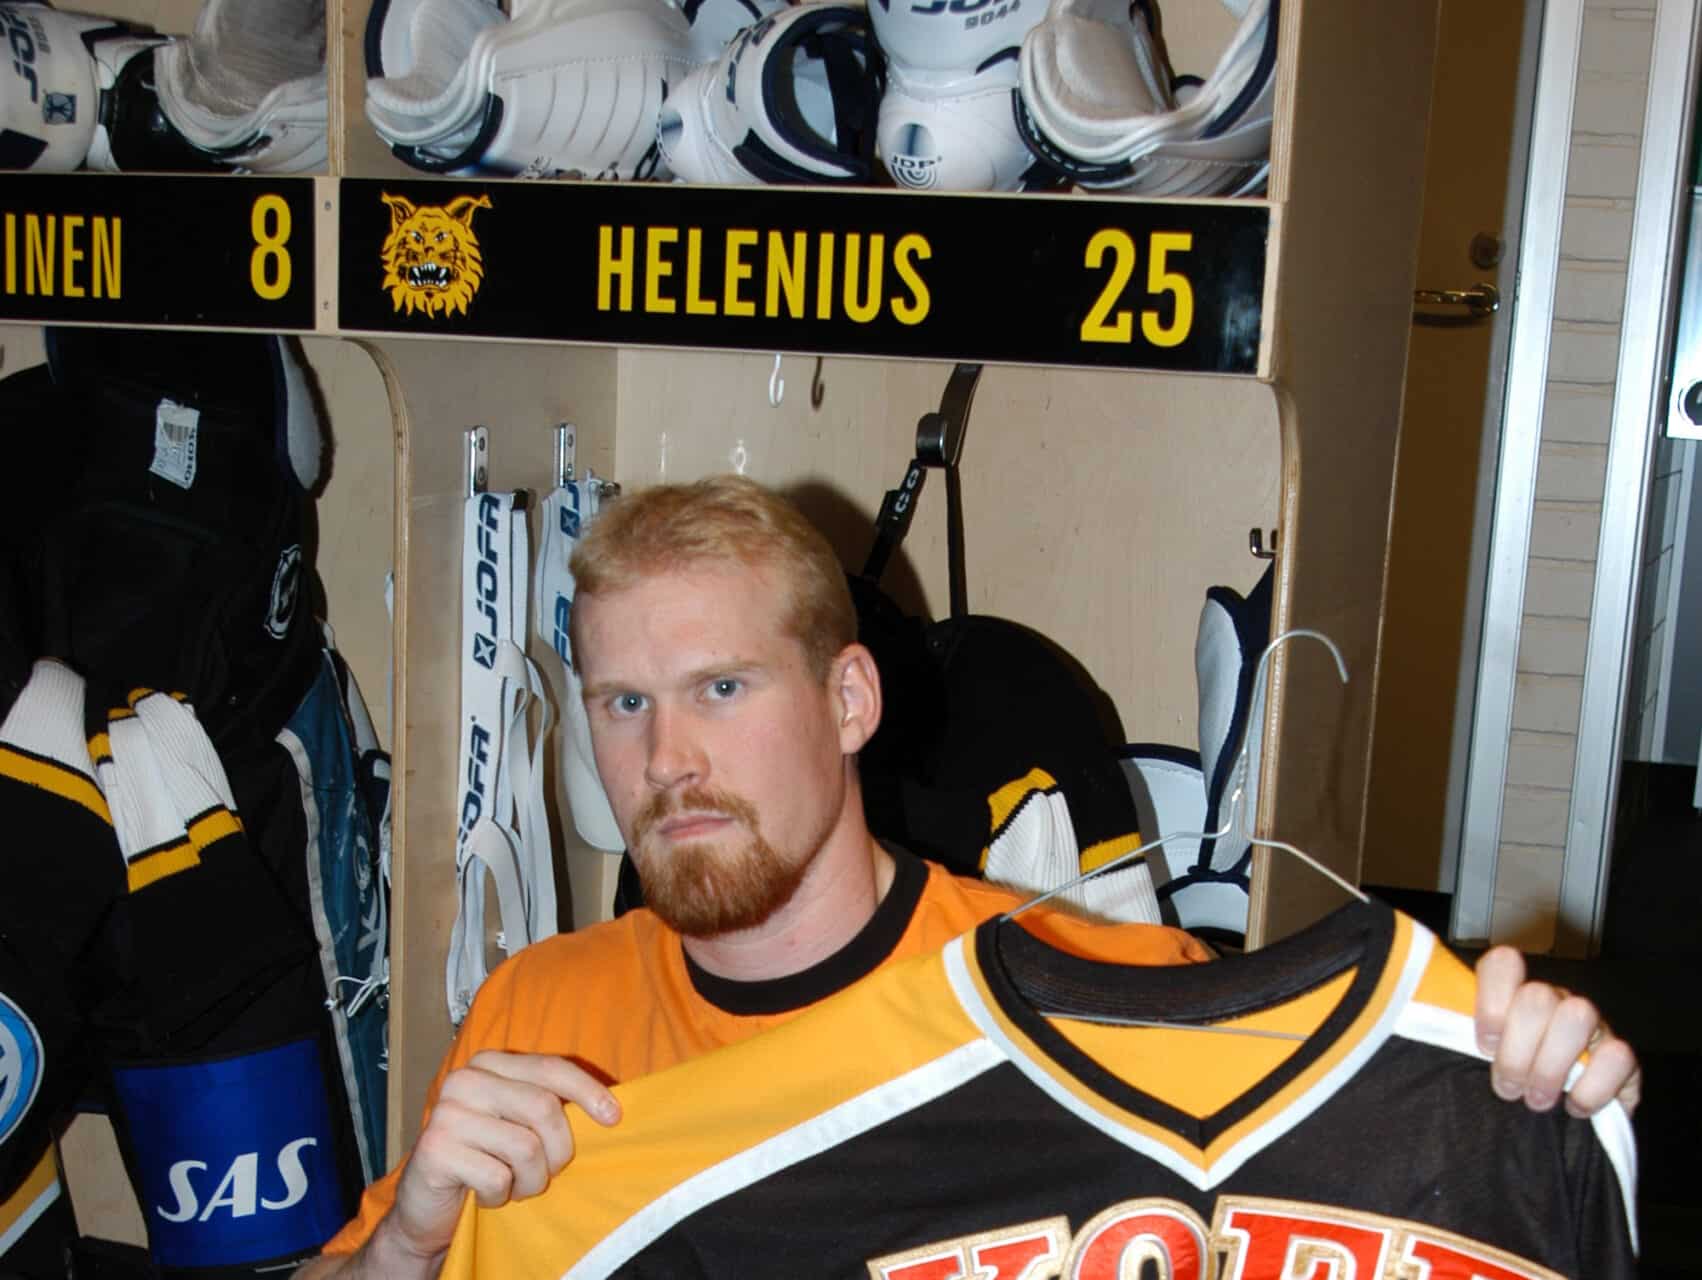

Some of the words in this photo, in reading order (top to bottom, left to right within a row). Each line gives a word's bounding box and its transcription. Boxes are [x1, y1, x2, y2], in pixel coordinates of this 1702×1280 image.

[4, 212, 122, 299] INEN
[251, 194, 292, 299] 8
[597, 225, 932, 325] HELENIUS
[1080, 229, 1194, 347] 25
[475, 494, 500, 639] JOFA
[157, 1137, 317, 1222] SAS
